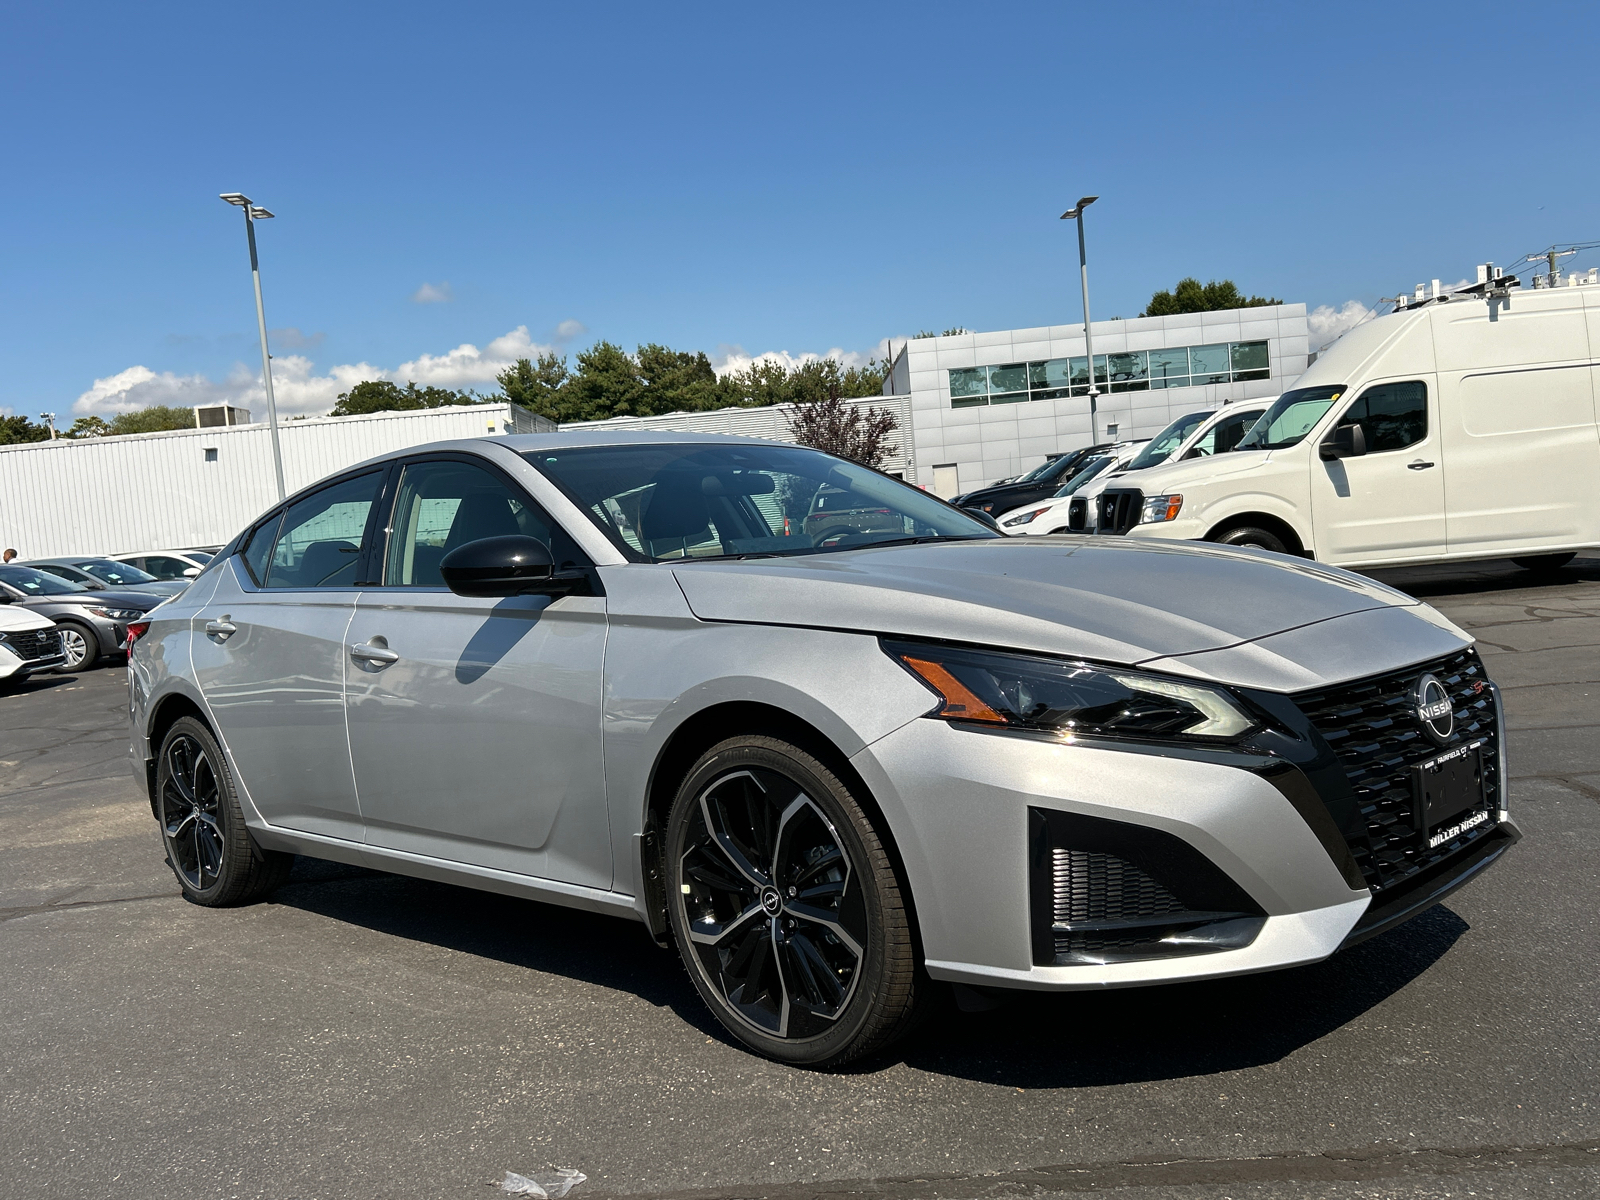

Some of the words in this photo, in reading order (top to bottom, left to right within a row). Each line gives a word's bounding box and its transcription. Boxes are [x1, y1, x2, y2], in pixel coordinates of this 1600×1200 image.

[1419, 699, 1453, 719] NISSAN
[1429, 826, 1460, 848] MILLER
[1459, 810, 1488, 832] NISSAN
